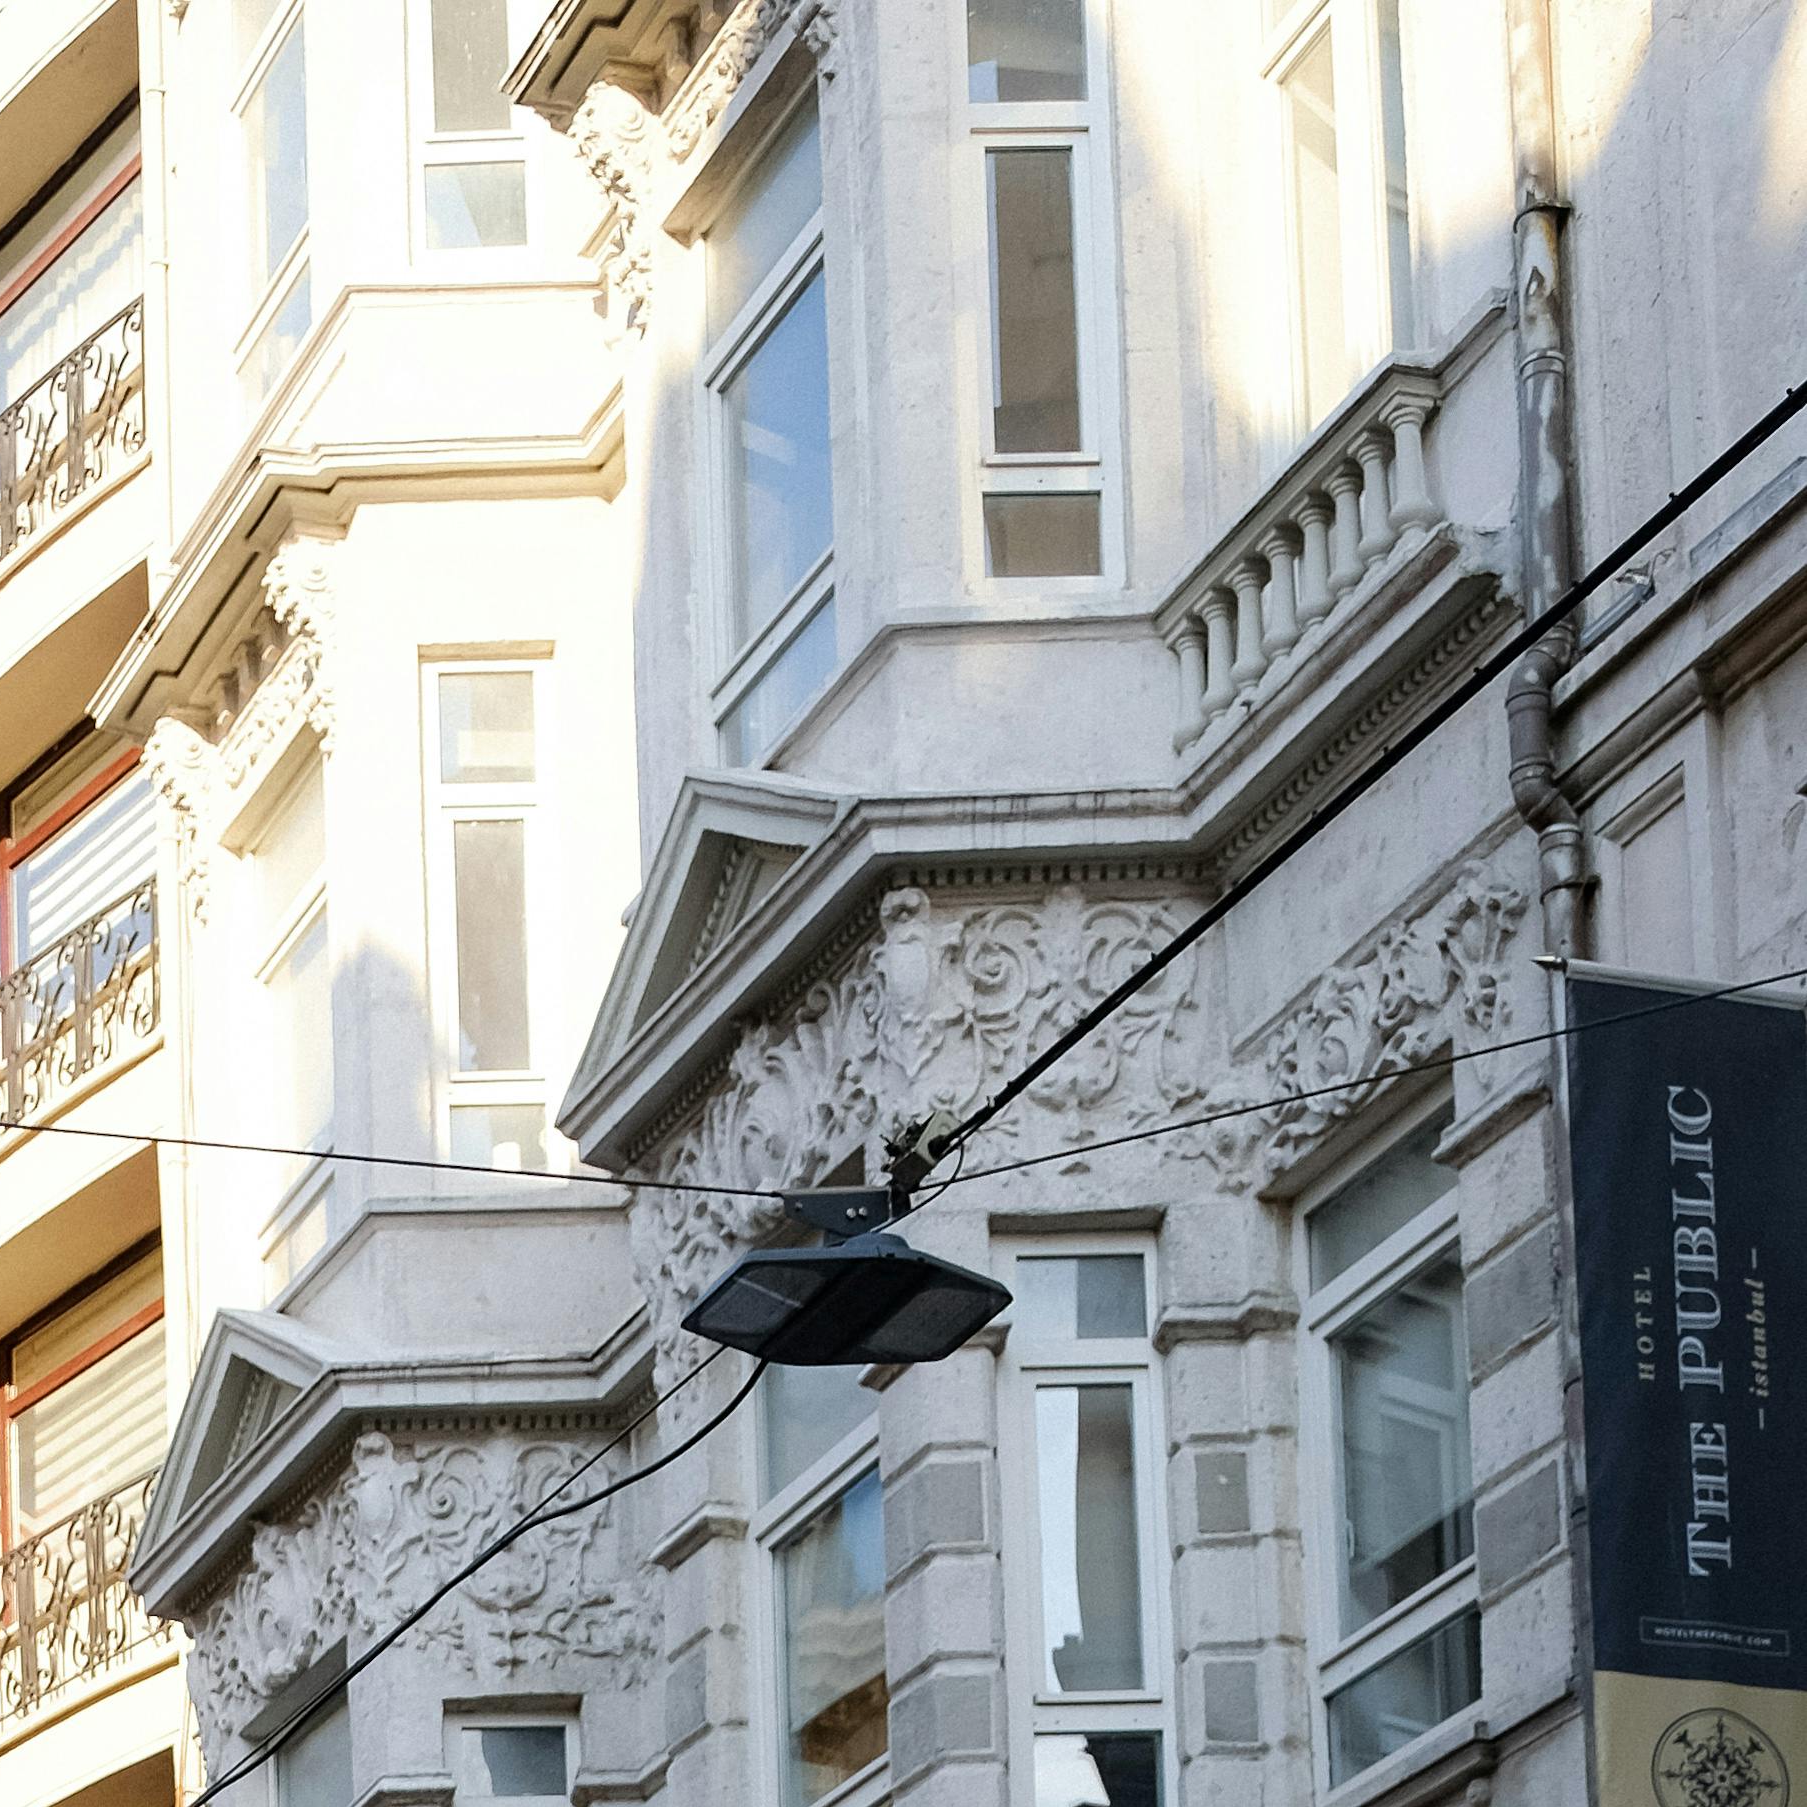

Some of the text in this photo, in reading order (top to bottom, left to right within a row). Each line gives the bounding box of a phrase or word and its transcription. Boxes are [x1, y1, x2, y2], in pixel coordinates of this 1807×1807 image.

[1633, 1266, 1656, 1381] HOTEL
[1667, 1085, 1732, 1577] THE PUBLIC
[1744, 1277, 1769, 1397] istanbul
